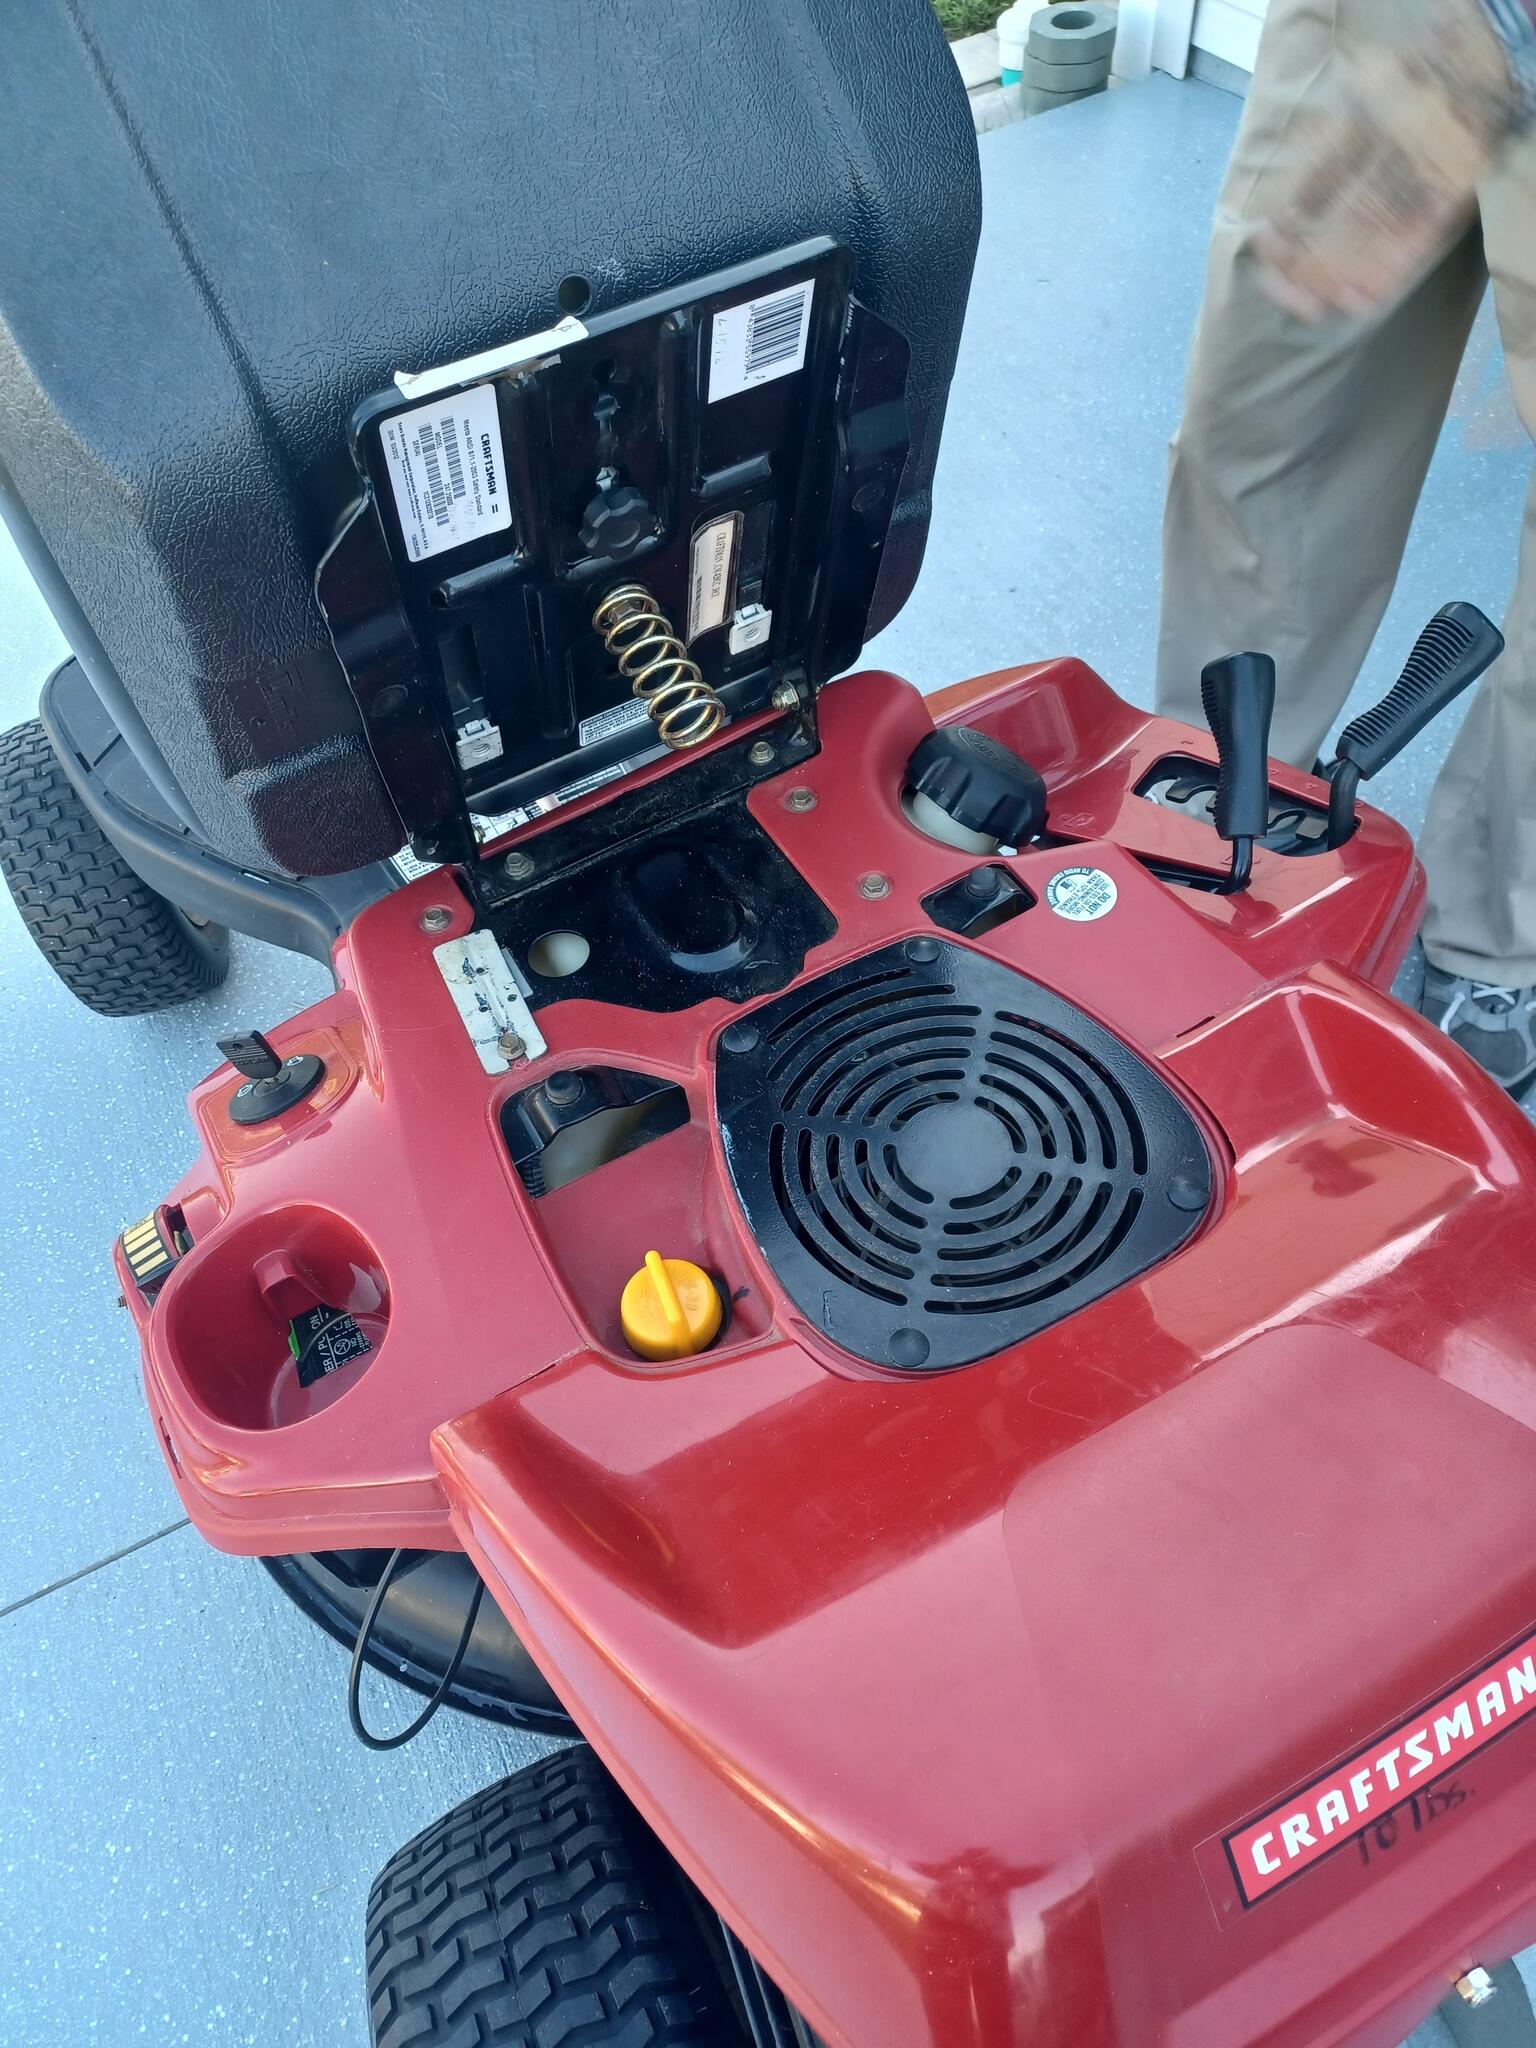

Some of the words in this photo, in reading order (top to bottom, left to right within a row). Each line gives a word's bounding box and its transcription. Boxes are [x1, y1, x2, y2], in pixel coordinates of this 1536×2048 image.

[412, 439, 421, 456] SERIAL
[434, 431, 442, 449] MODEL
[479, 432, 497, 495] CRAFTSMAN
[465, 436, 473, 449] ANSI
[474, 494, 483, 515] Standard
[1086, 872, 1100, 885] THAN
[1097, 892, 1110, 903] DO
[1064, 899, 1079, 914] MORE
[1072, 904, 1084, 916] FUEL
[1085, 900, 1101, 915] NOT
[1251, 1655, 1536, 1875] CRAFTSMAN
